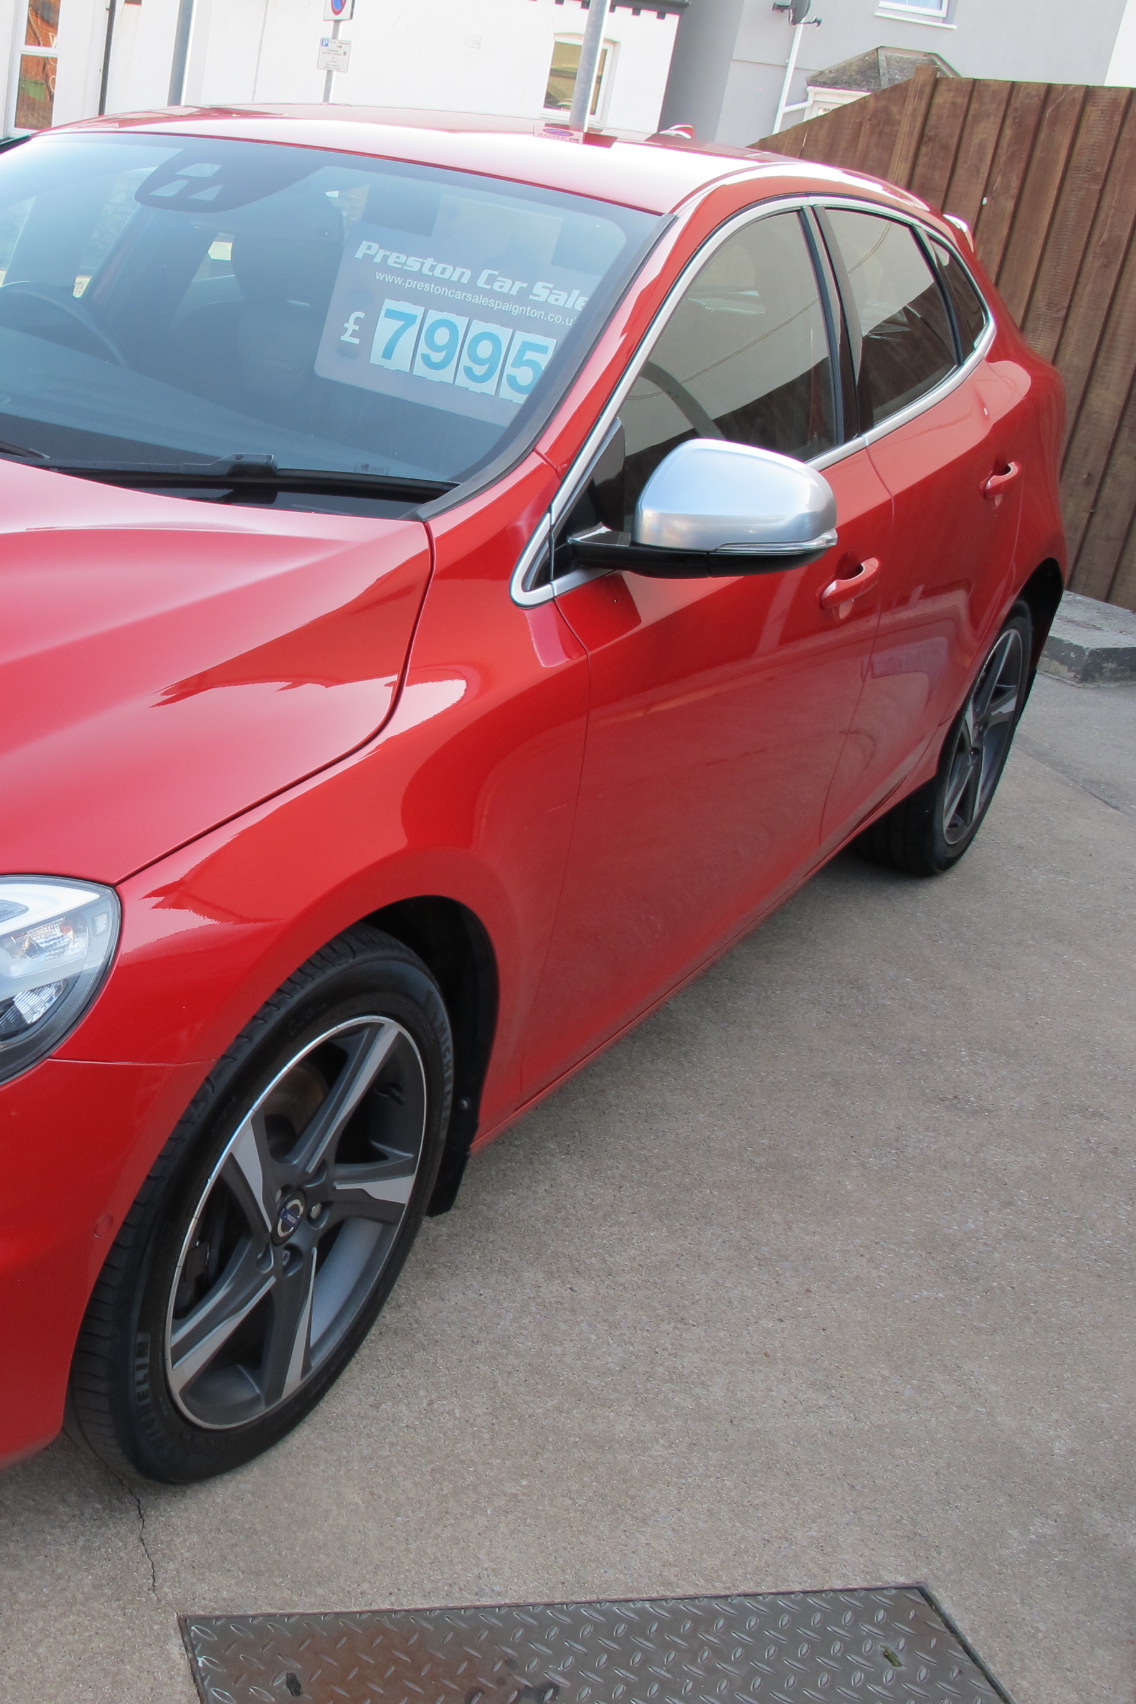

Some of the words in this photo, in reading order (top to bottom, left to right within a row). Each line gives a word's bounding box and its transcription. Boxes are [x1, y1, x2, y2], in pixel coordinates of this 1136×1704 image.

[354, 240, 472, 284] Preston
[476, 268, 528, 296] Car
[375, 271, 577, 327] www.prestoncarsalespaignton.co.u
[340, 311, 365, 345] £
[380, 308, 550, 395] 7995
